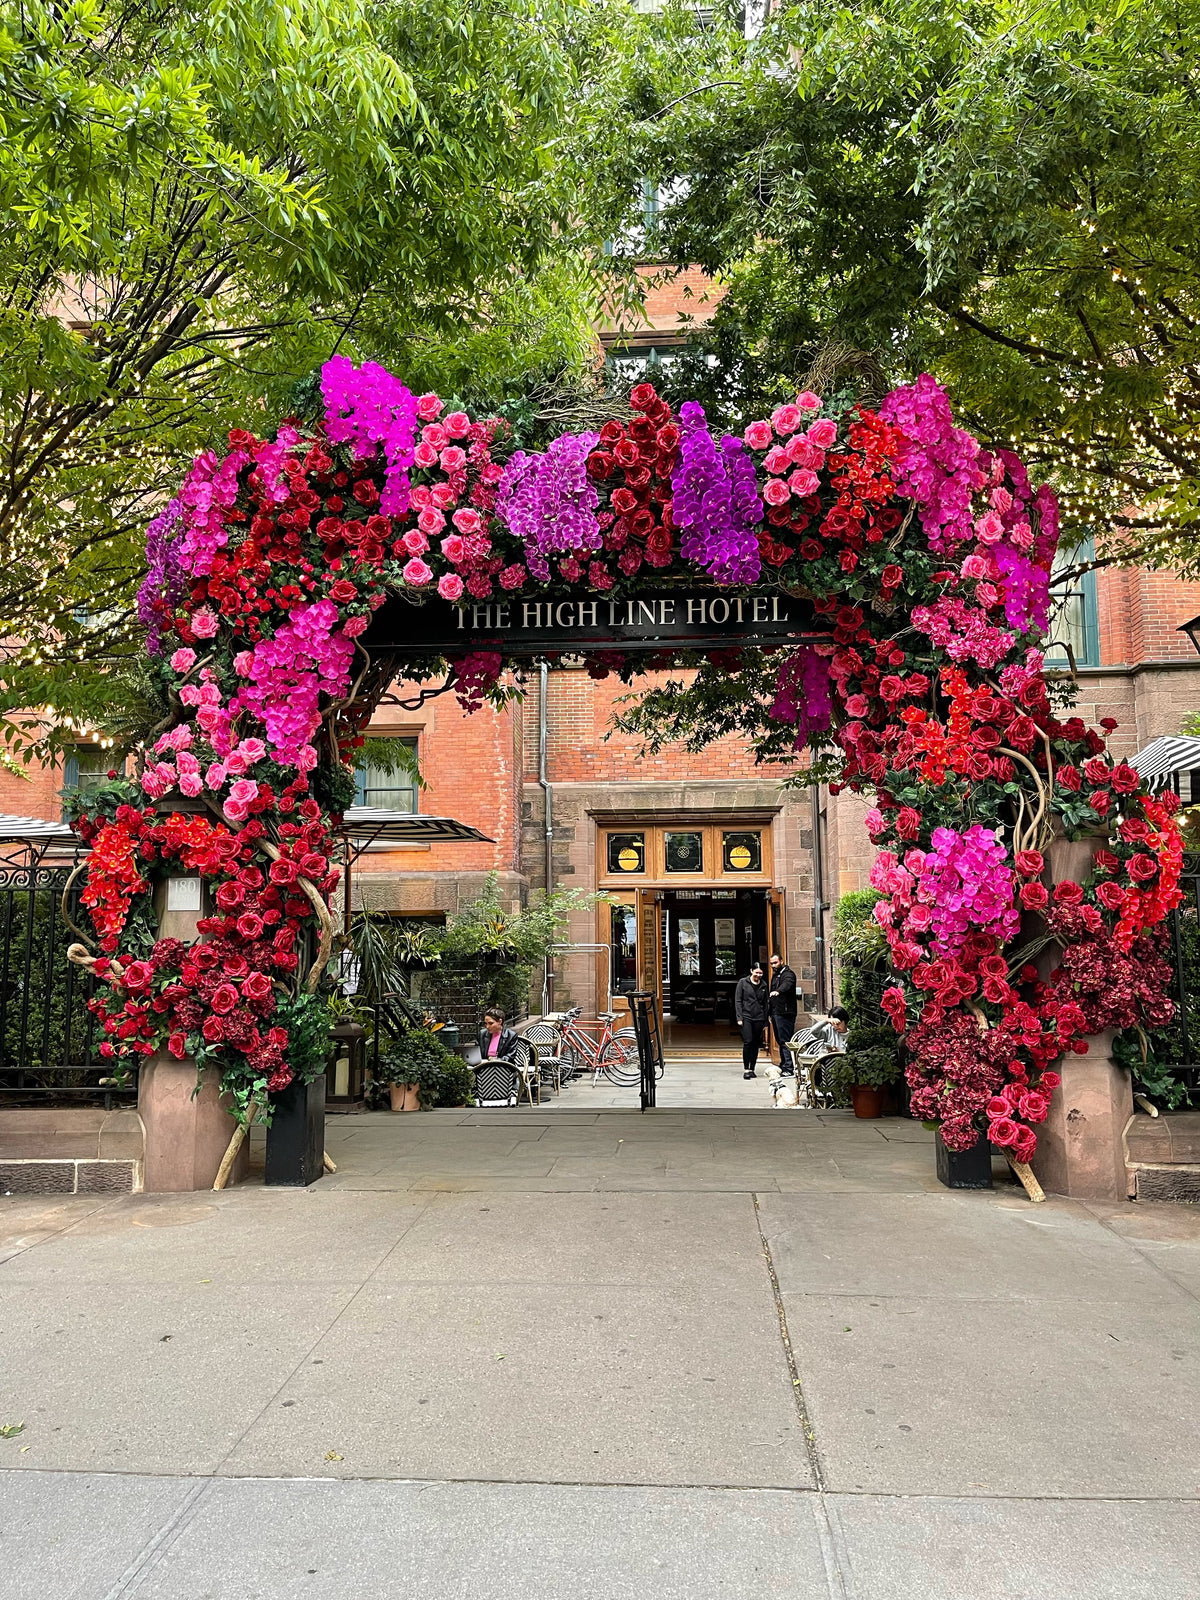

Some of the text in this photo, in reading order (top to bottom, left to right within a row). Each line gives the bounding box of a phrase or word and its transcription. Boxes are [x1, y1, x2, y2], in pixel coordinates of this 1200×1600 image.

[452, 597, 789, 629] THE HIGH LINE HOTEL
[174, 880, 196, 894] 180
